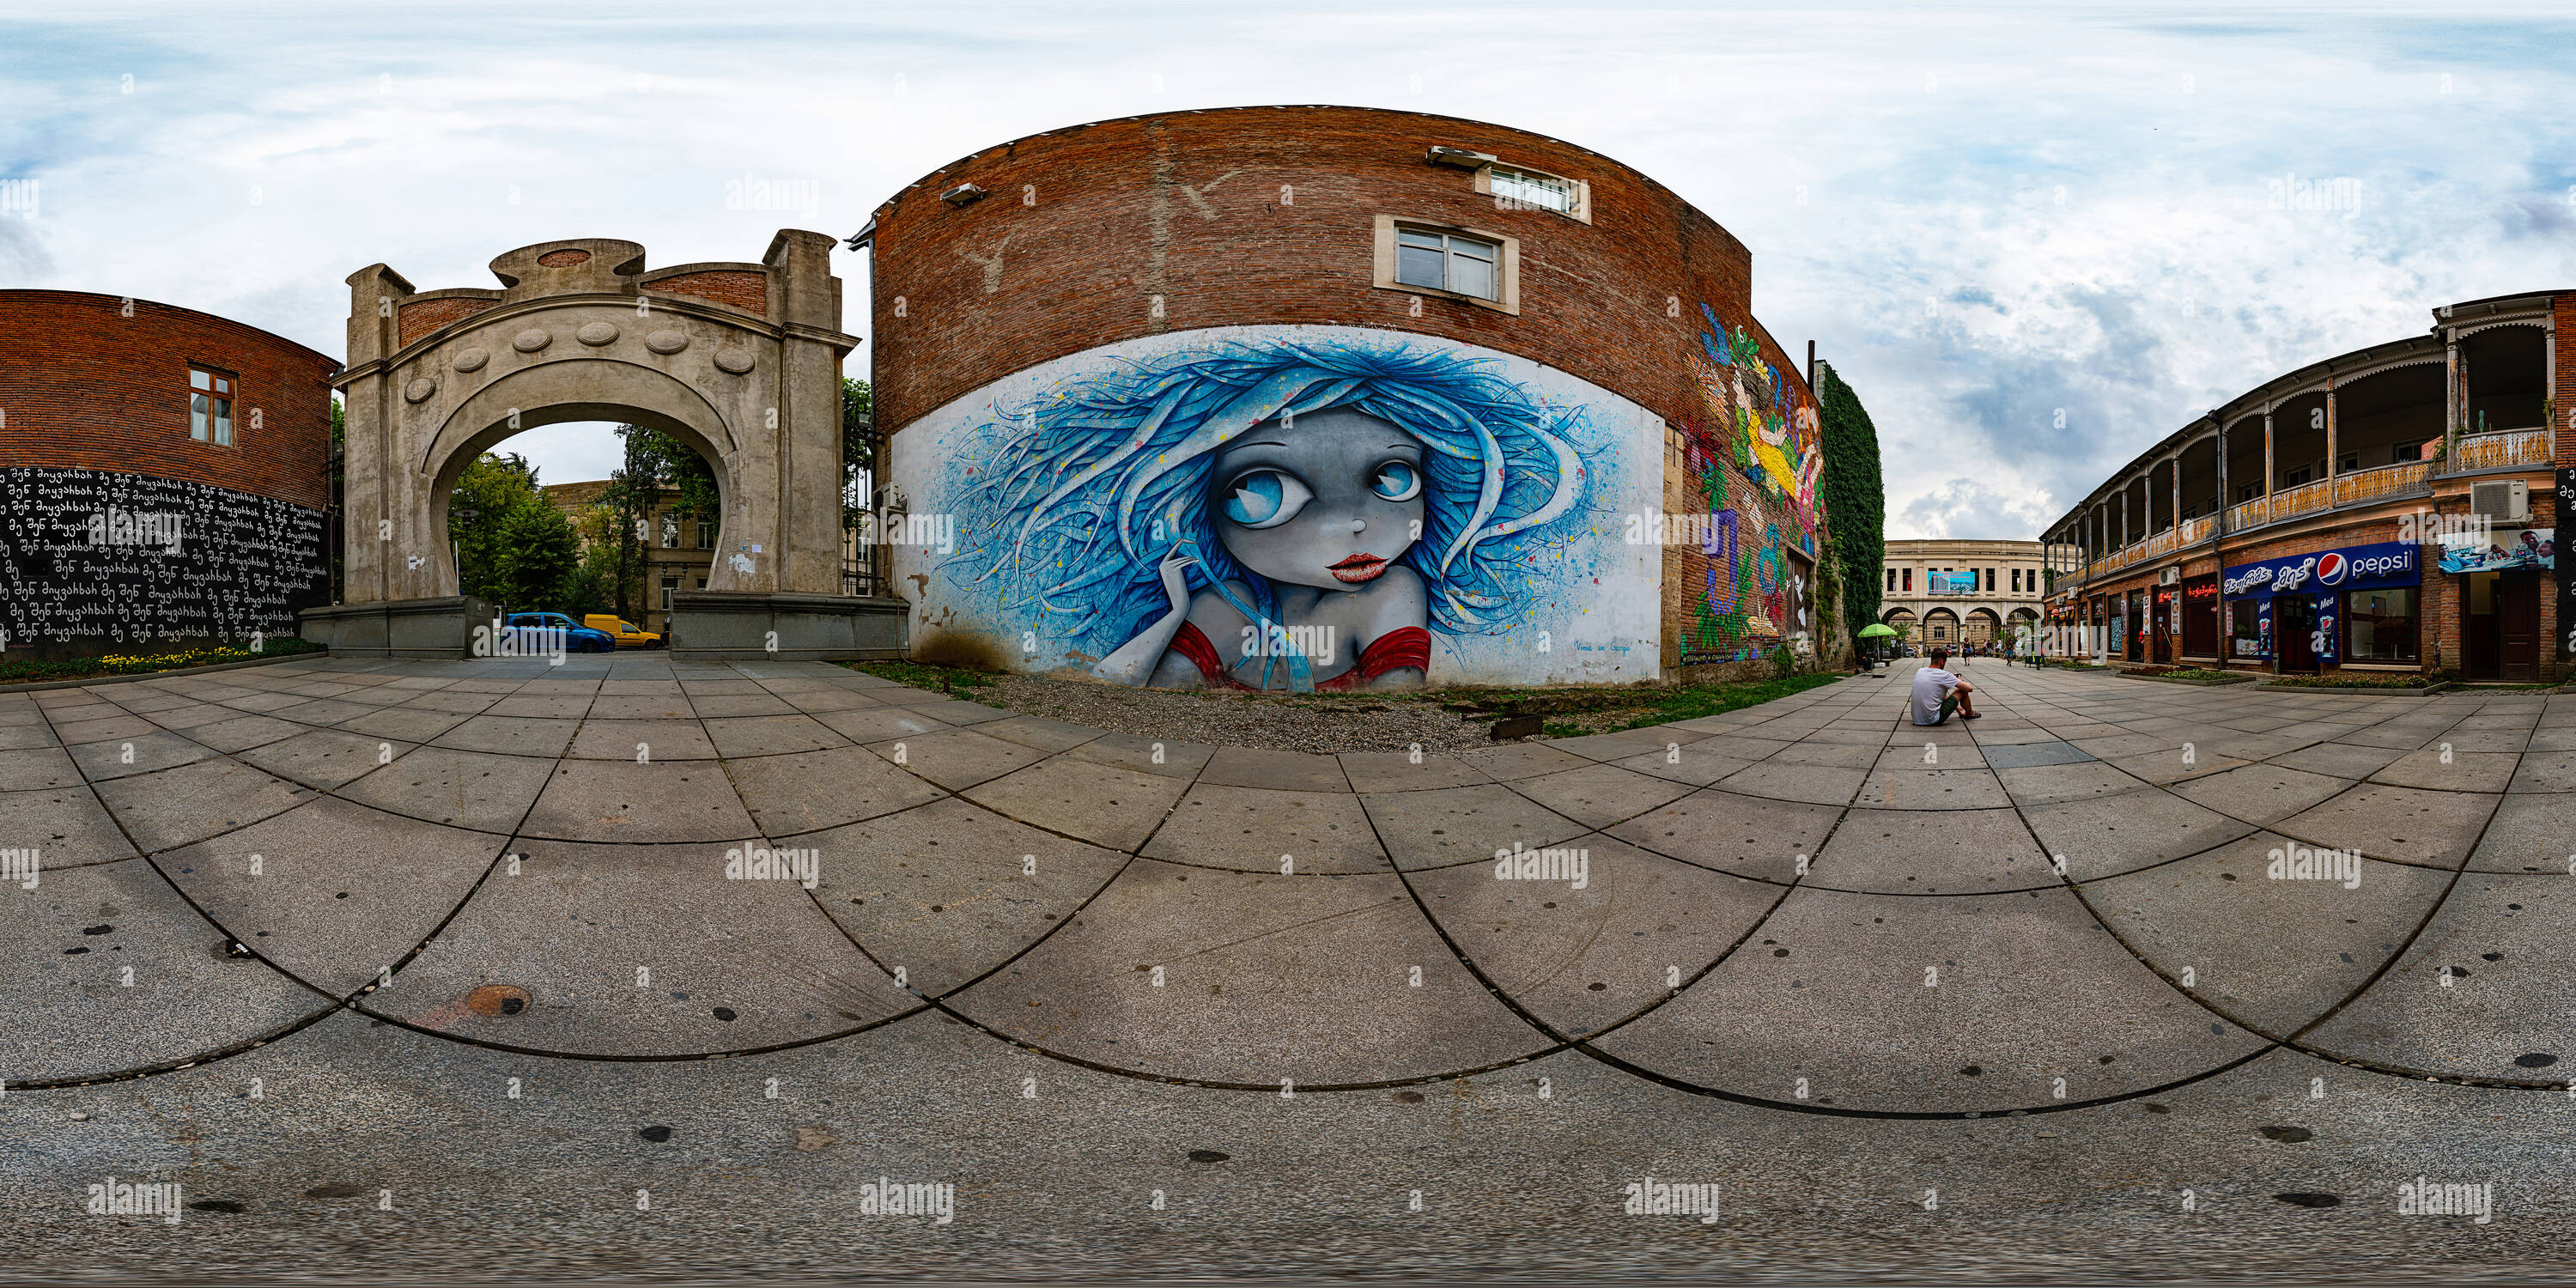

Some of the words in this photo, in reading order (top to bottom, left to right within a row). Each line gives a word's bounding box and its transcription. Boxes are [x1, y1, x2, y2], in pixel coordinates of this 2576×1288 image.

[8, 484, 31, 499] შენ
[96, 487, 107, 501] მე
[112, 488, 130, 502] შენ
[185, 496, 194, 510] მე
[198, 498, 215, 513] შენ
[264, 510, 272, 523] მე
[275, 513, 288, 526] შენ
[10, 468, 31, 482] შენ
[99, 472, 109, 485] მე
[114, 473, 132, 488] შენ
[187, 483, 196, 496] მე
[200, 485, 216, 498] შენ
[263, 497, 270, 509] მე
[273, 500, 286, 513] შენ
[12, 500, 32, 515] შენ
[181, 510, 191, 526] მე
[194, 512, 210, 528] შენ
[257, 522, 266, 537] მე
[269, 526, 283, 540] შენ
[9, 518, 22, 536] მე
[26, 517, 46, 536] შენ
[200, 529, 210, 548] მე
[213, 532, 229, 550] შენ
[269, 540, 277, 557] მე
[278, 542, 291, 559] შენ
[6, 559, 19, 580] მე
[53, 560, 77, 580] შენ
[143, 564, 155, 583] მე
[158, 564, 178, 584] შენ
[238, 572, 249, 589] მე
[253, 573, 271, 591] შენ
[20, 539, 40, 556] შენ
[116, 542, 134, 560] შენ
[192, 548, 203, 565] მე
[207, 550, 226, 568] შენ
[275, 561, 284, 575] მე
[286, 561, 300, 577] შენ
[2353, 551, 2410, 577] pepsi
[13, 581, 37, 601] შენ
[101, 583, 115, 602] მე
[119, 583, 141, 602] შენ
[207, 588, 218, 605] მე
[223, 589, 240, 607] შენ
[10, 603, 24, 621] მე
[30, 602, 54, 621] შენ
[118, 604, 129, 622] მე
[133, 604, 154, 621] შენ
[213, 607, 224, 624] მე
[228, 608, 246, 624] შენ
[17, 623, 40, 642] შენ
[111, 623, 123, 643] მე
[131, 624, 153, 643] შენ
[218, 626, 228, 643] მე
[235, 626, 252, 642] შენ
